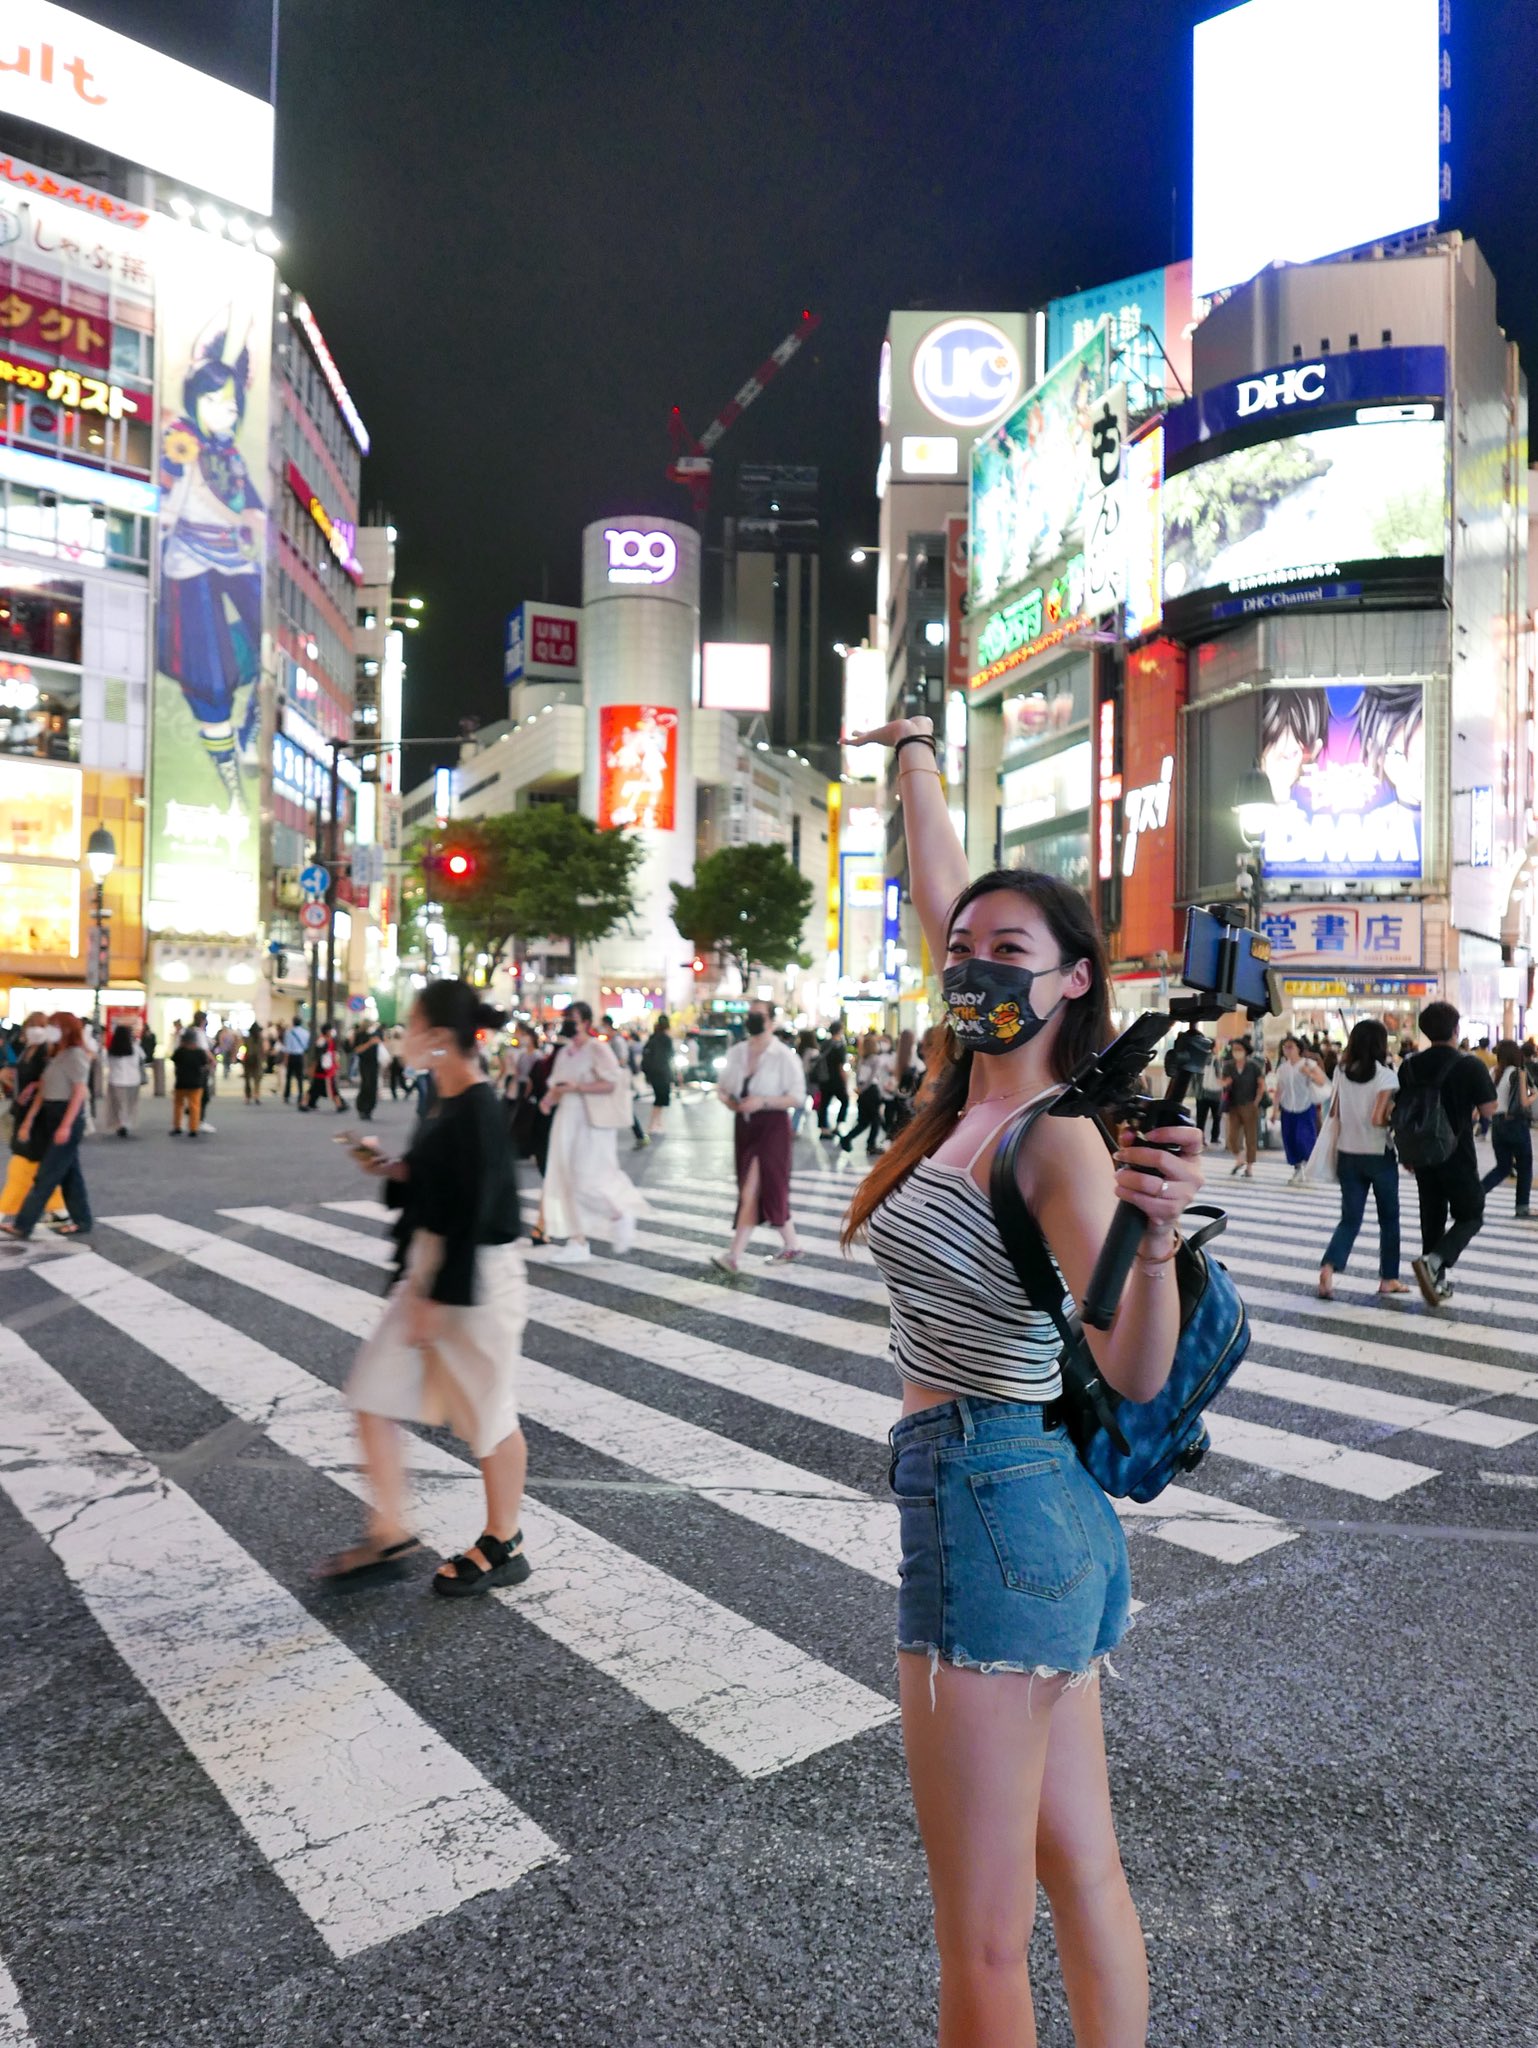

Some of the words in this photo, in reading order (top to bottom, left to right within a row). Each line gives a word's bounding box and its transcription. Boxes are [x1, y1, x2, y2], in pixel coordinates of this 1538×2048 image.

[47, 369, 138, 420] ガスト
[1236, 364, 1326, 417] DHC
[603, 528, 678, 584] 109
[1242, 593, 1271, 613] DHC
[1271, 586, 1323, 607] Channel
[535, 621, 571, 641] UNI
[534, 641, 574, 662] QLO
[1261, 914, 1403, 951] 堂書店
